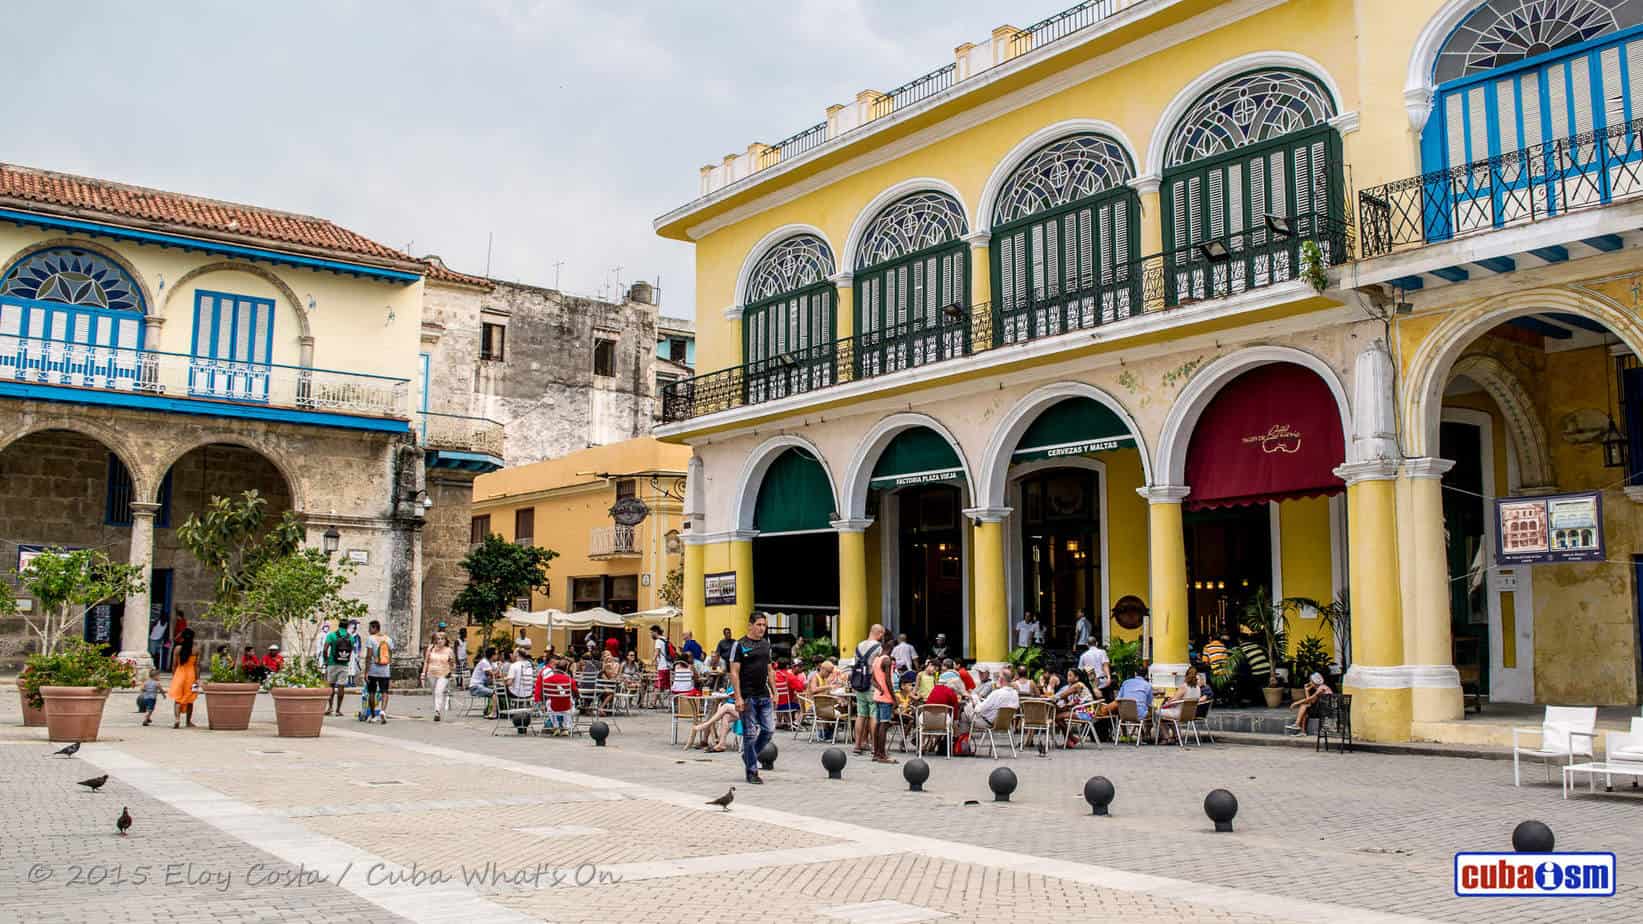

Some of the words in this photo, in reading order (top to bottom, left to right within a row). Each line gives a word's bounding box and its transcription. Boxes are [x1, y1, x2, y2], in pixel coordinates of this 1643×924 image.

[1047, 446, 1082, 457] CERVEZAS
[1082, 445, 1089, 453] Y
[1089, 441, 1118, 451] MALTAS
[896, 476, 922, 485] FACTORIA
[922, 474, 940, 483] PLAZA
[940, 472, 957, 480] VIEJA
